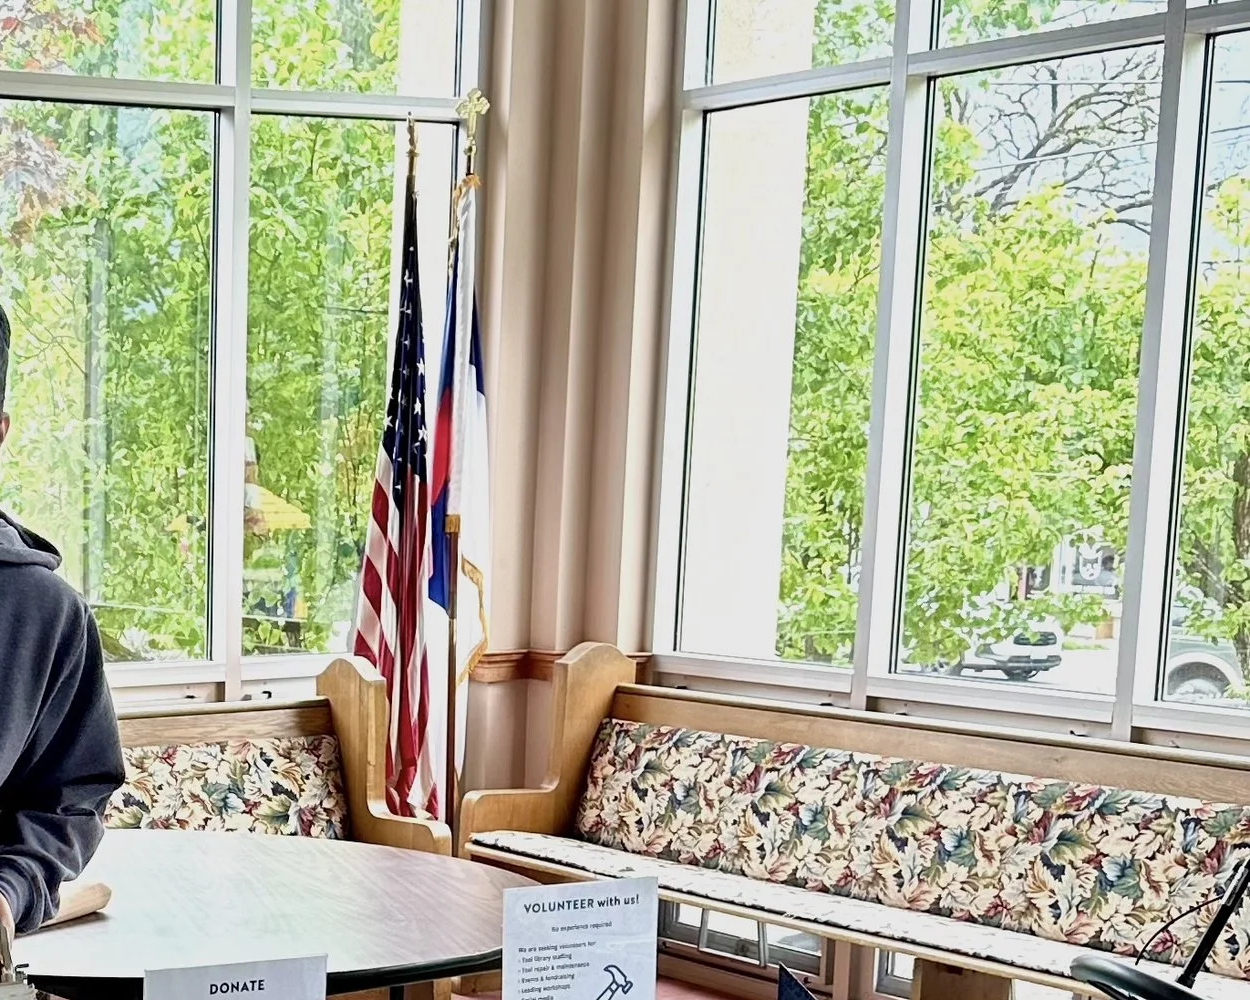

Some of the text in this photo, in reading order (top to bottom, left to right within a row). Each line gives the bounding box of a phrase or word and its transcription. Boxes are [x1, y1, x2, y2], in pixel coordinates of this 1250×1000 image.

[524, 894, 640, 914] VOLUNTEER with us!
[590, 921, 612, 930] required
[209, 979, 265, 995] DONATE
